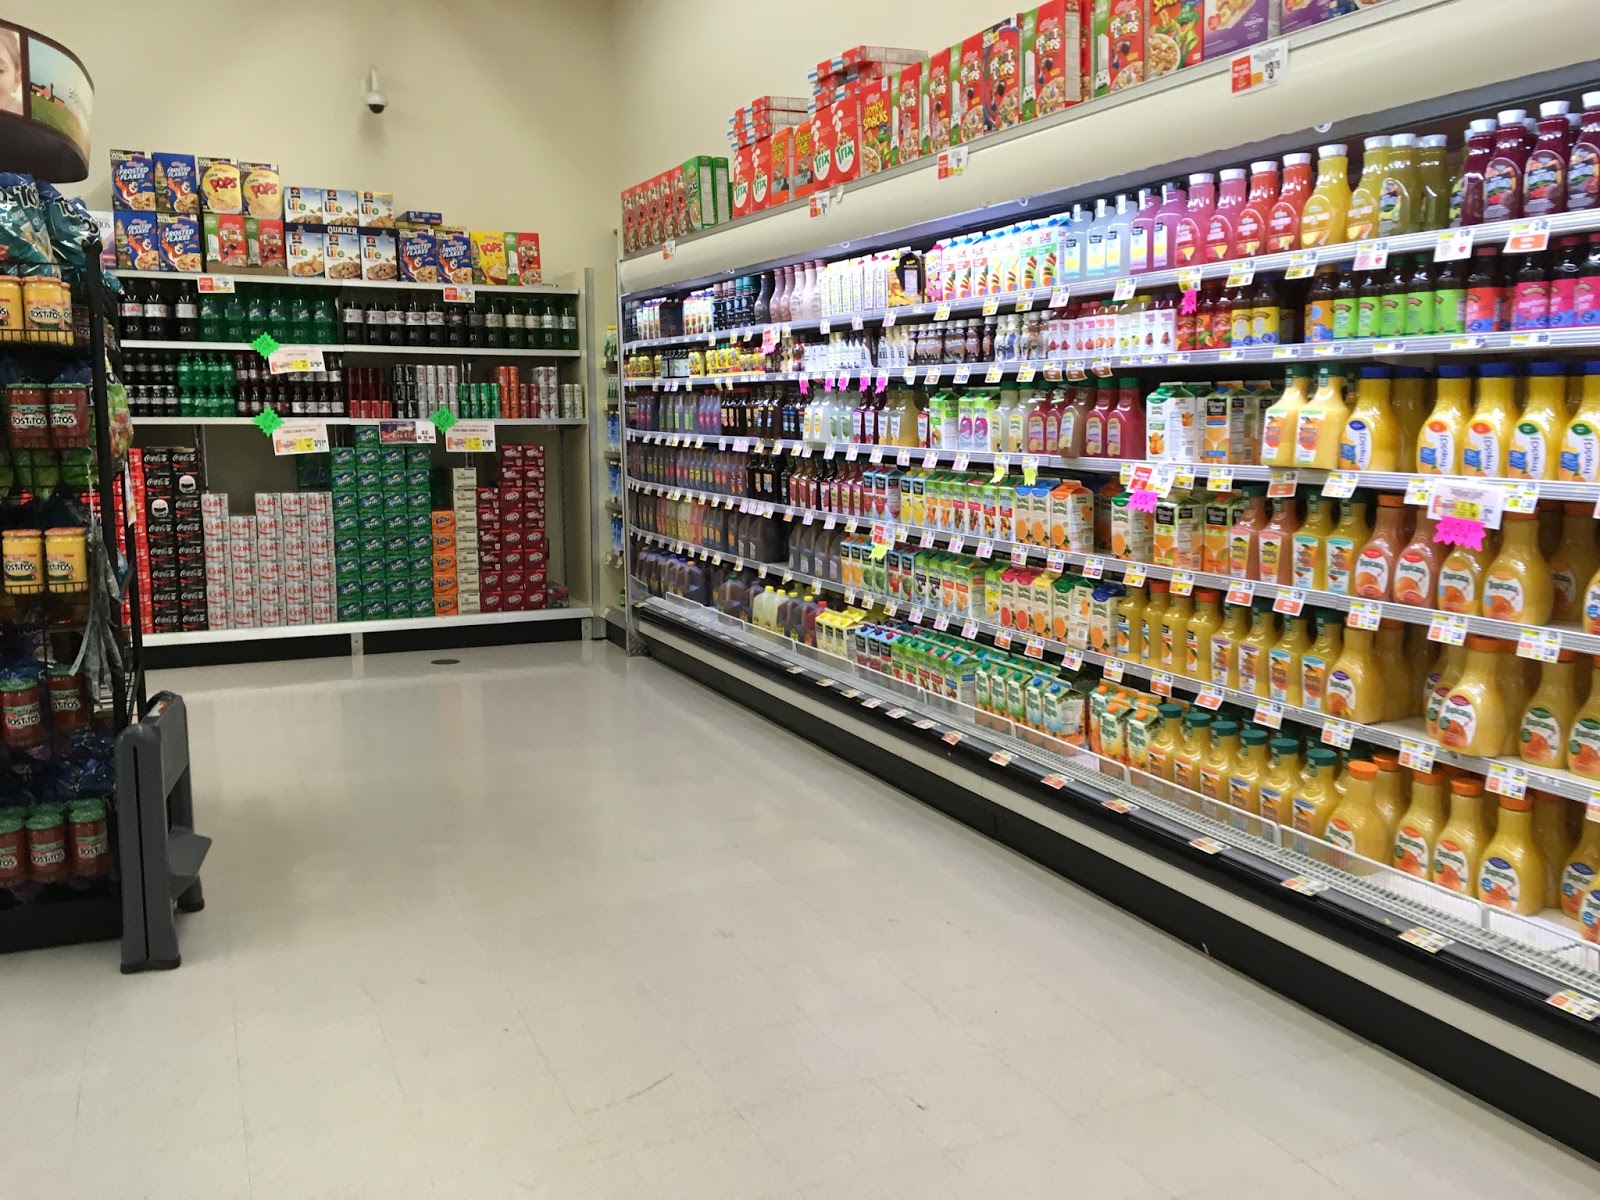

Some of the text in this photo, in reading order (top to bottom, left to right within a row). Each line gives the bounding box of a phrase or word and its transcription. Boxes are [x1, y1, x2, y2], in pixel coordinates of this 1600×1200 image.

[209, 177, 237, 192] POPS
[251, 182, 277, 198] POPS
[166, 229, 194, 237] FROSTED
[327, 226, 357, 235] QUAKER
[406, 243, 431, 251] FROSTED
[480, 242, 502, 256] POPS
[30, 309, 61, 319] TOSTITOS
[12, 416, 46, 425] TOSTITOS
[7, 715, 39, 725] TOSTITOS
